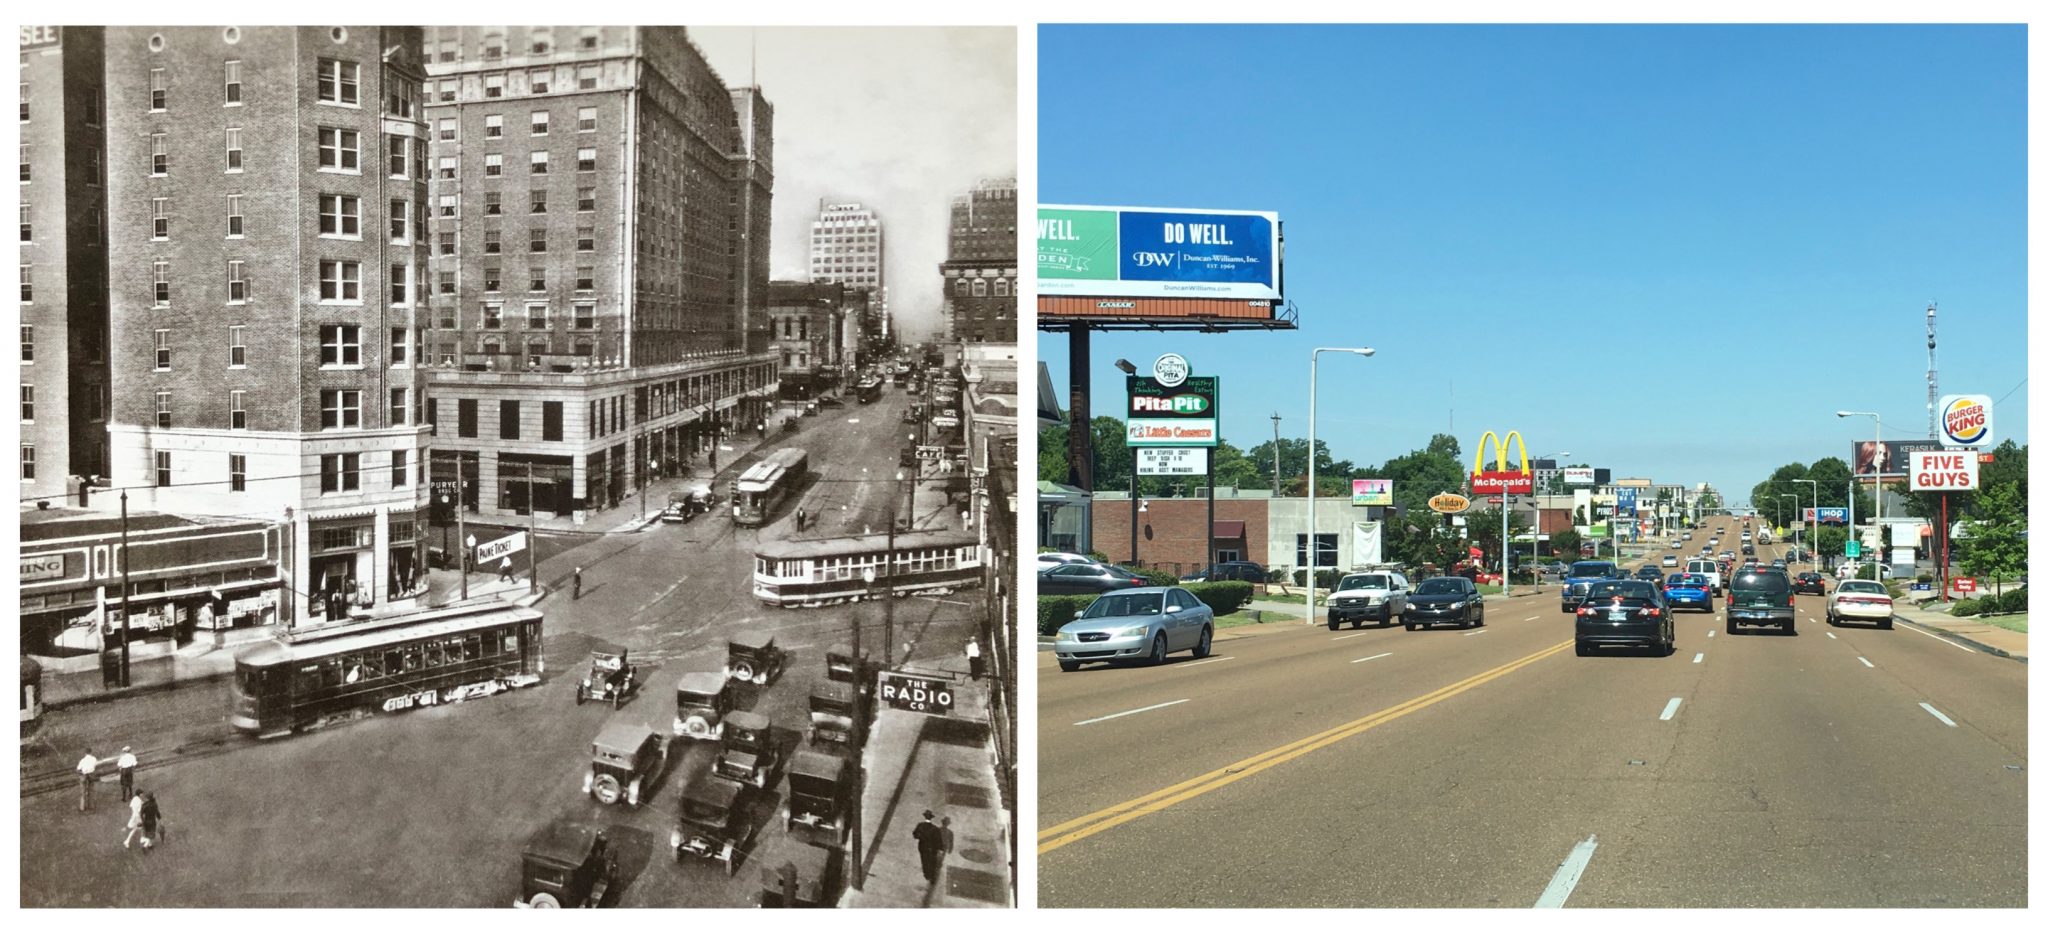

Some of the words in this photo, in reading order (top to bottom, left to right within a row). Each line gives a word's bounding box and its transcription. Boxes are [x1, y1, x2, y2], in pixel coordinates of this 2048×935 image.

[1037, 218, 1080, 240] WELL.
[1164, 222, 1185, 244] DO
[1189, 223, 1234, 245] WELL.
[1183, 253, 1246, 264] Duncan-Williams,
[1163, 284, 1232, 292] DuncanWilliams.com
[1946, 405, 1984, 423] BURGER
[1948, 413, 1985, 435] KING
[1145, 426, 1172, 438] Little
[1173, 426, 1212, 438] Caesars
[1922, 455, 1965, 470] FIVE
[430, 480, 469, 489] PURYER
[1918, 472, 1970, 487] GUYS
[1434, 497, 1470, 508] Holiday
[907, 679, 928, 689] THE
[883, 684, 951, 705] RADIO
[910, 701, 925, 711] CO
